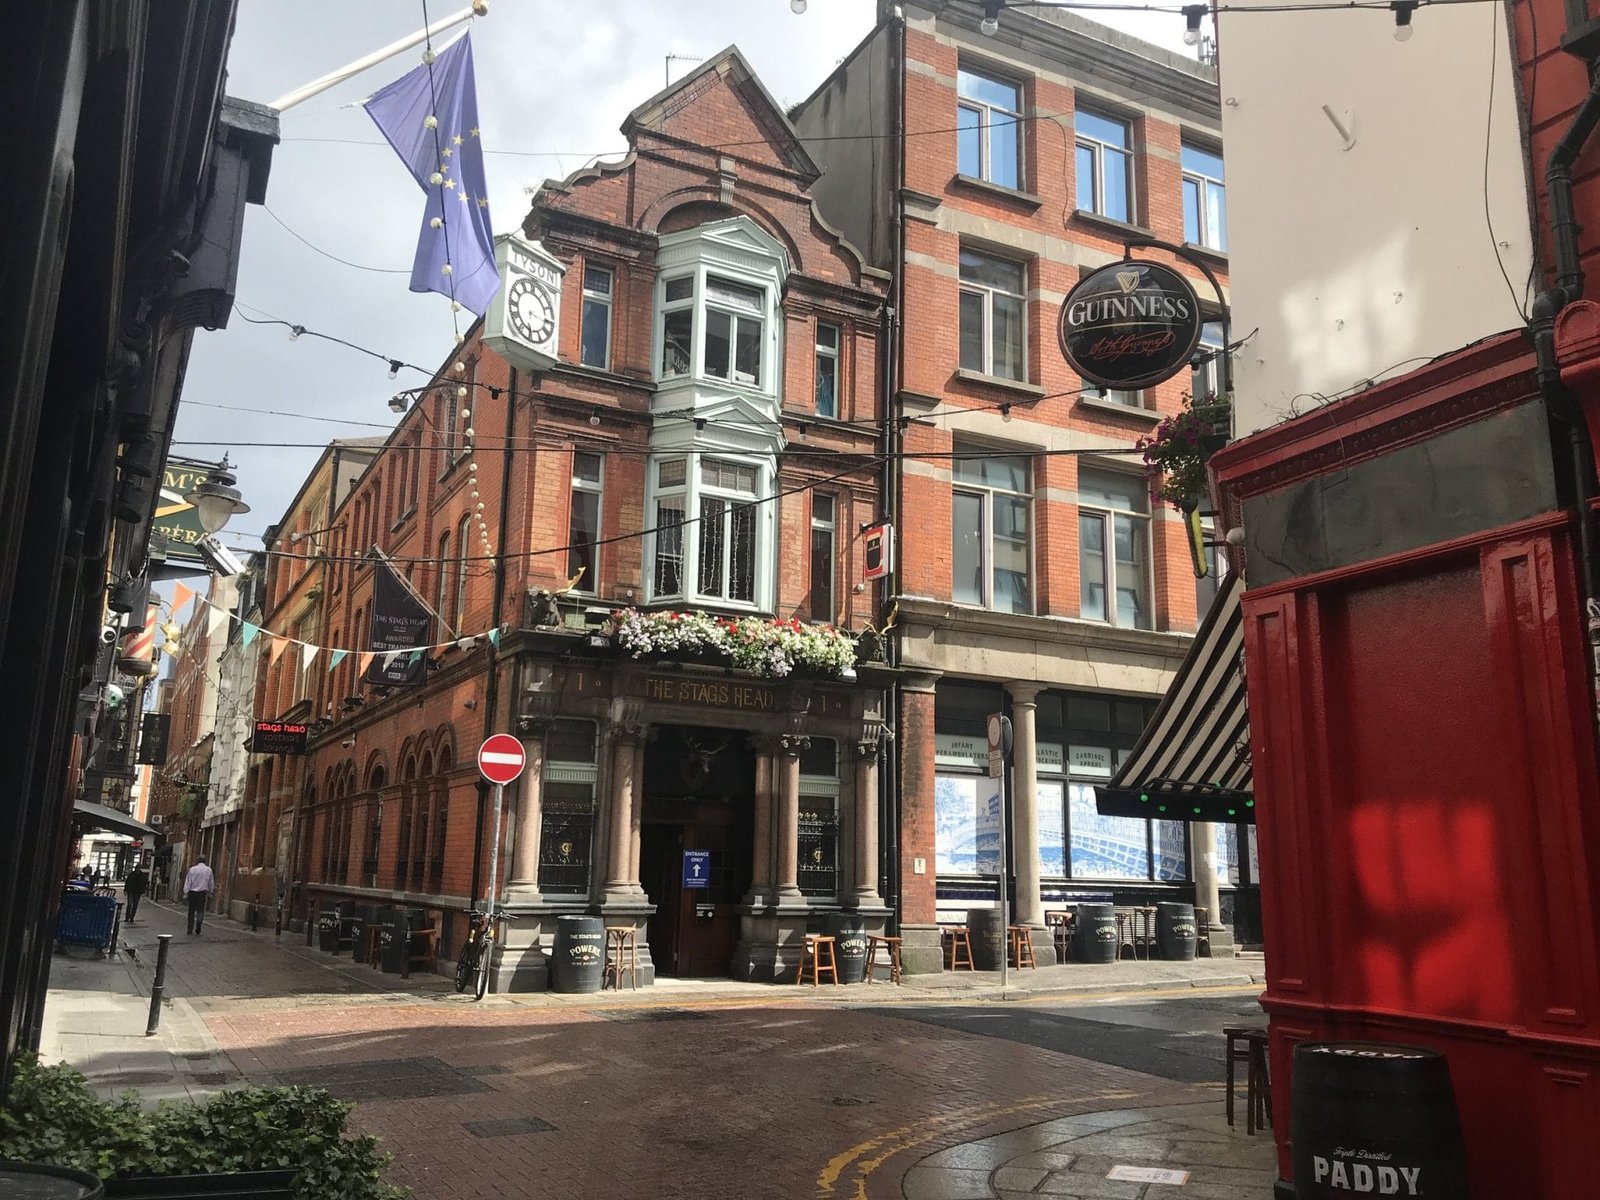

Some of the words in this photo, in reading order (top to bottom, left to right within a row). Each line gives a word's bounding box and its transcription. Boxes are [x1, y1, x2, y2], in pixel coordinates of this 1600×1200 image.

[514, 252, 555, 284] TYSON
[1068, 295, 1189, 326] GUINNESS
[384, 634, 415, 643] AWARDED
[373, 641, 387, 649] BEST
[646, 679, 674, 699] THE
[734, 687, 774, 709] HEAD
[1037, 749, 1059, 757] LASTIC
[1075, 752, 1105, 762] CARRIAGE
[1080, 760, 1102, 768] APRONS
[1333, 1147, 1354, 1158] Triple
[1356, 1150, 1393, 1161] Distilled
[1313, 1155, 1421, 1195] PADDY
